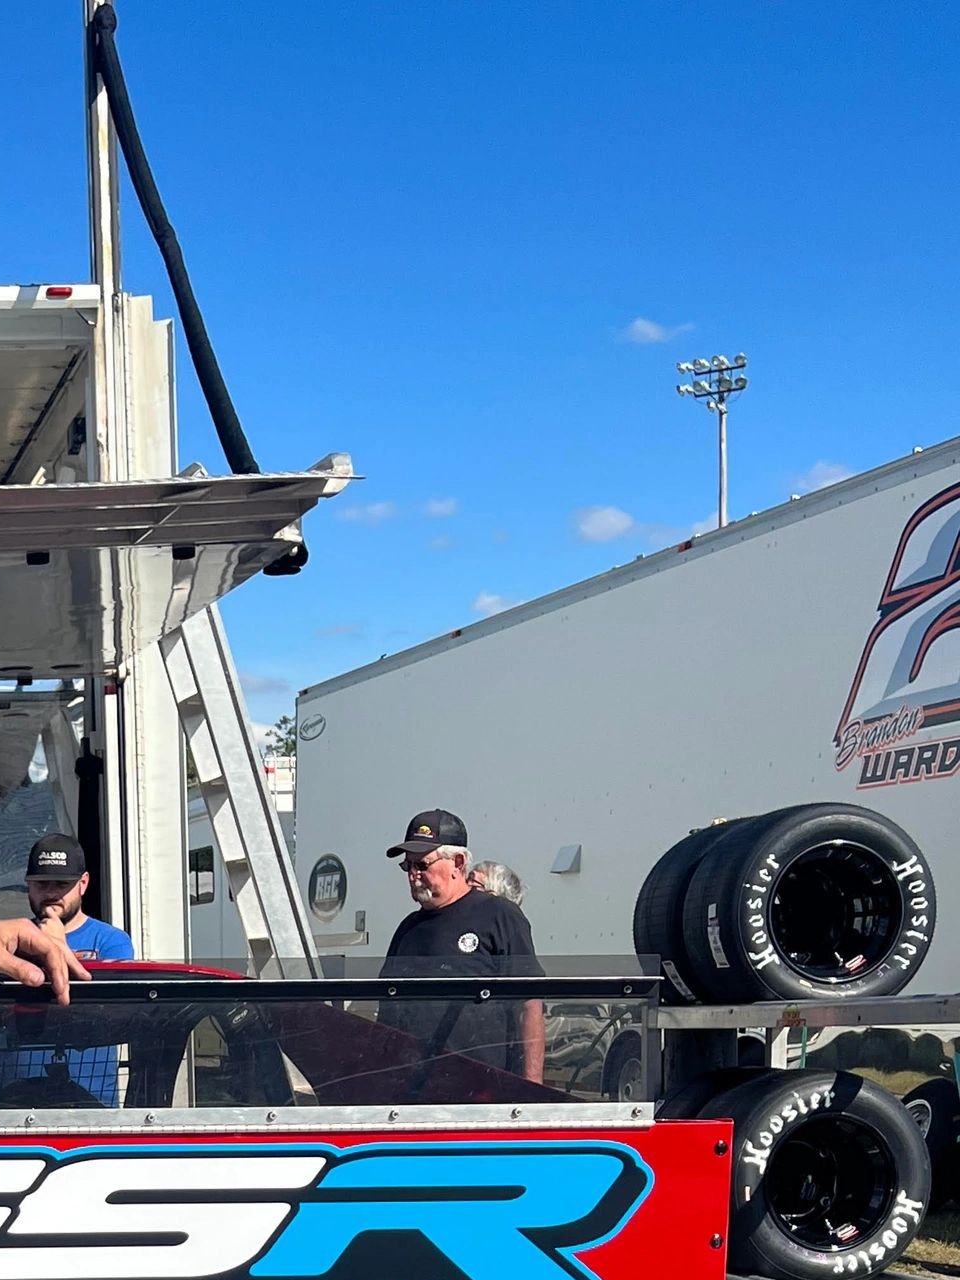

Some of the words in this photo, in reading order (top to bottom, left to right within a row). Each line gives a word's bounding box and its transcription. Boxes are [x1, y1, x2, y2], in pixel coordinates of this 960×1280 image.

[836, 704, 923, 768] Brandon
[858, 739, 960, 785] WARD
[743, 853, 780, 971] Hoosier
[891, 854, 929, 970] Hoosier
[743, 1090, 836, 1175] Hoosier
[832, 1189, 923, 1274] Hoosier
